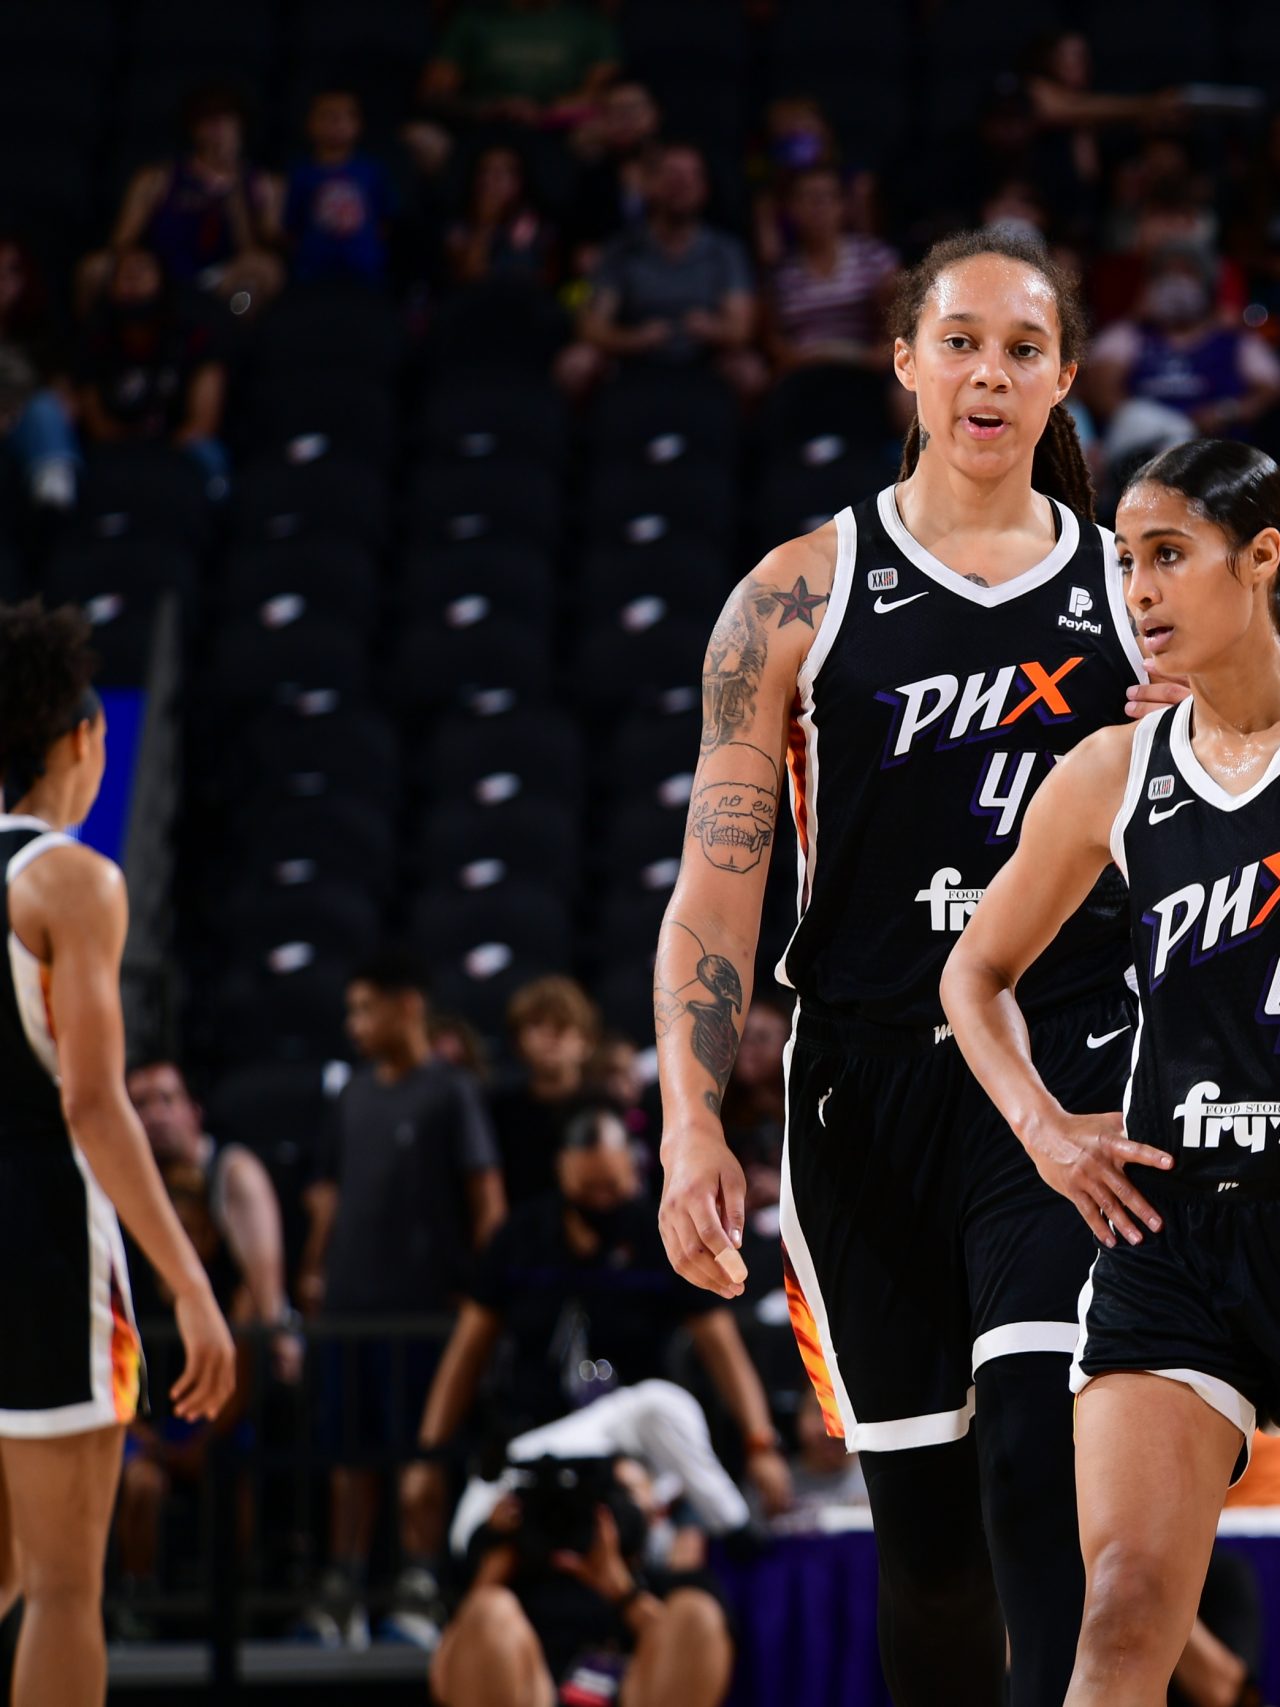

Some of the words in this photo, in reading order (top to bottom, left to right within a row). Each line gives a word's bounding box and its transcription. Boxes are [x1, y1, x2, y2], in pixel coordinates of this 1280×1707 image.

[1058, 615, 1102, 635] PayPal
[889, 656, 1084, 759] PHX
[718, 794, 744, 809] no
[978, 752, 1064, 836] 4
[1205, 1104, 1241, 1116] FOOD
